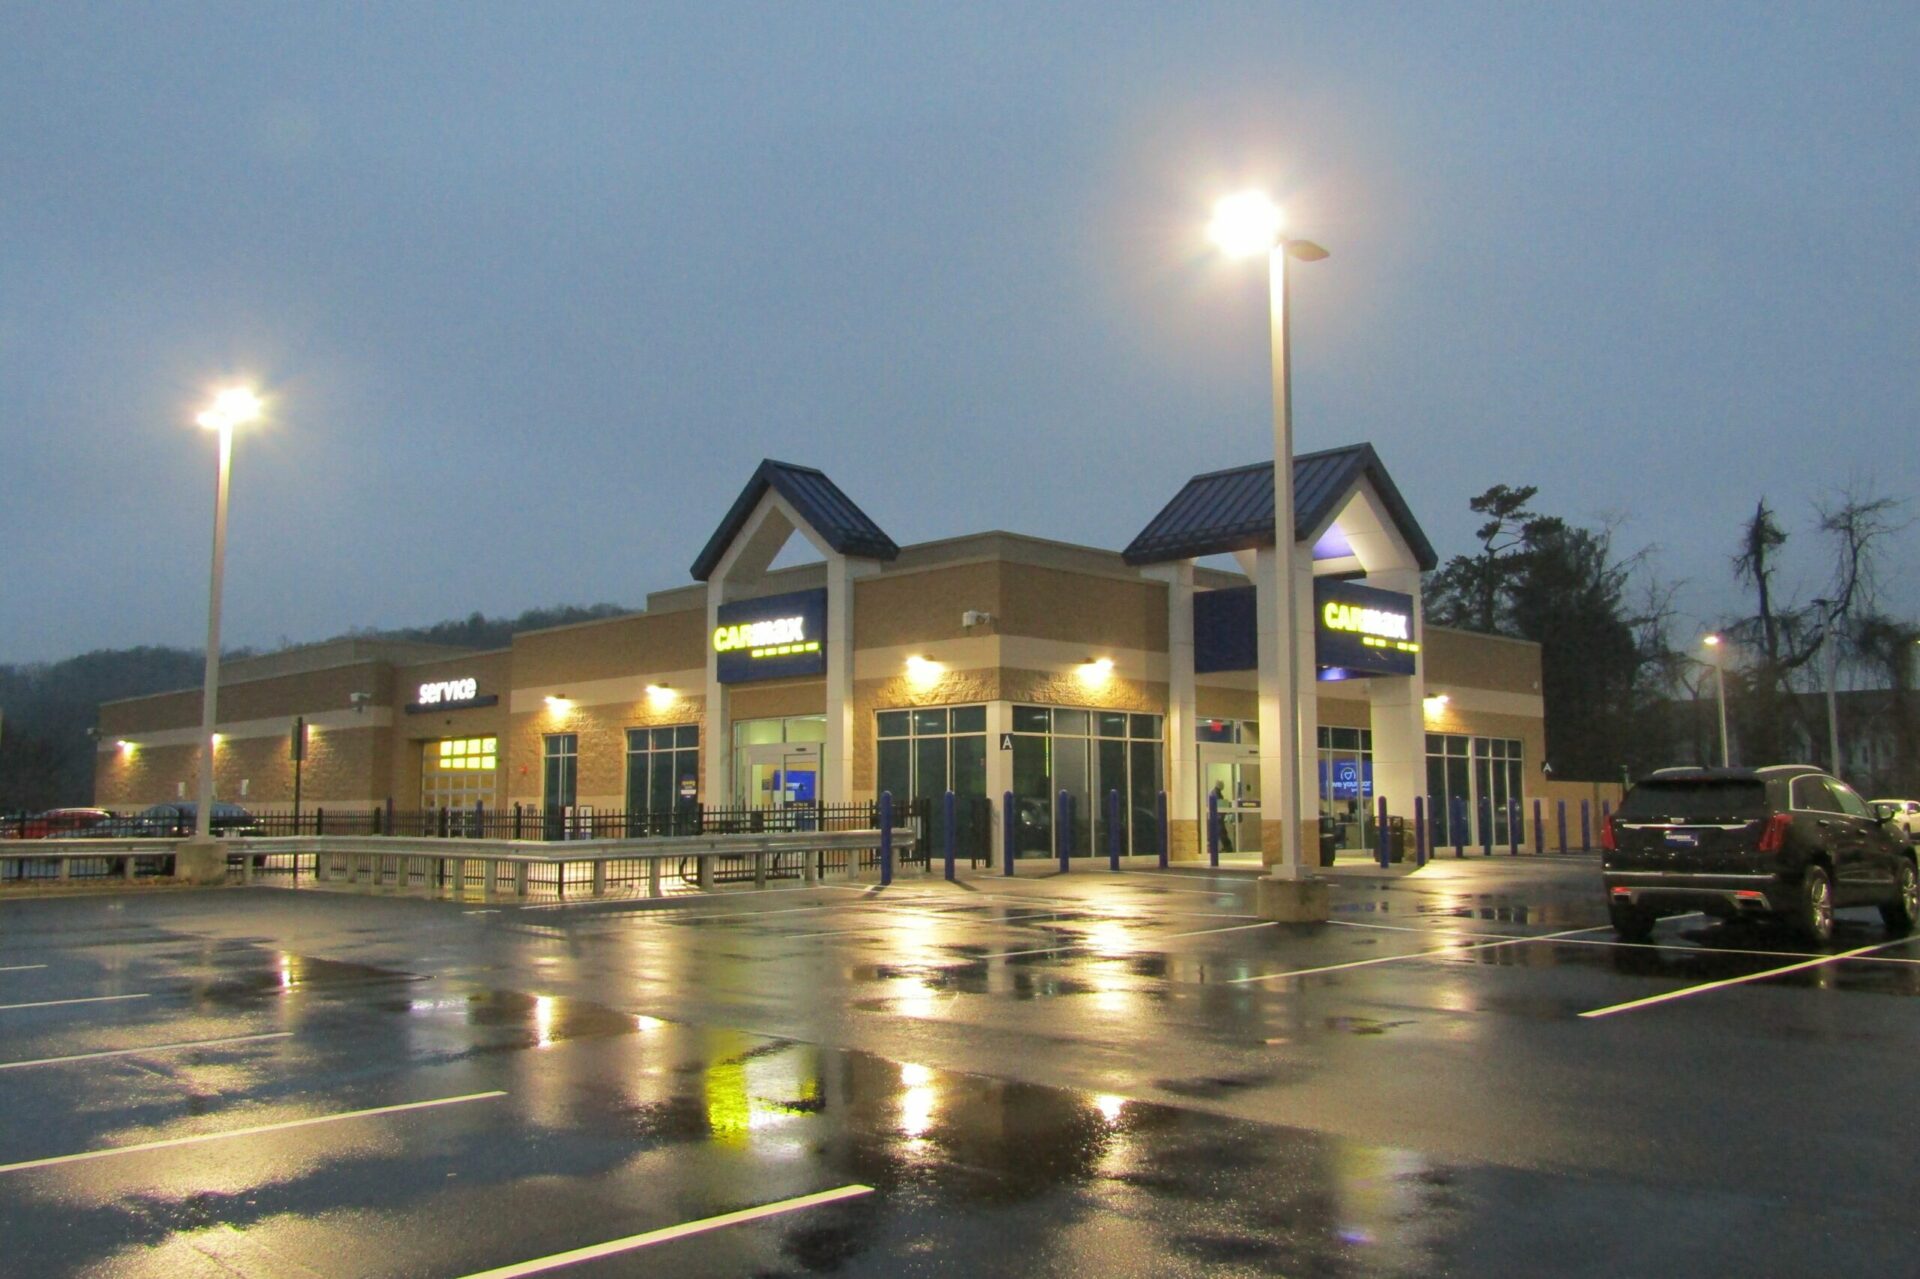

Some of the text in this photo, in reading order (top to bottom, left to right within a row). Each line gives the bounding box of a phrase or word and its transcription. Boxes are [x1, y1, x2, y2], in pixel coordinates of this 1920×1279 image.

[419, 678, 477, 705] service
[1002, 734, 1013, 750] A
[1543, 762, 1552, 773] A
